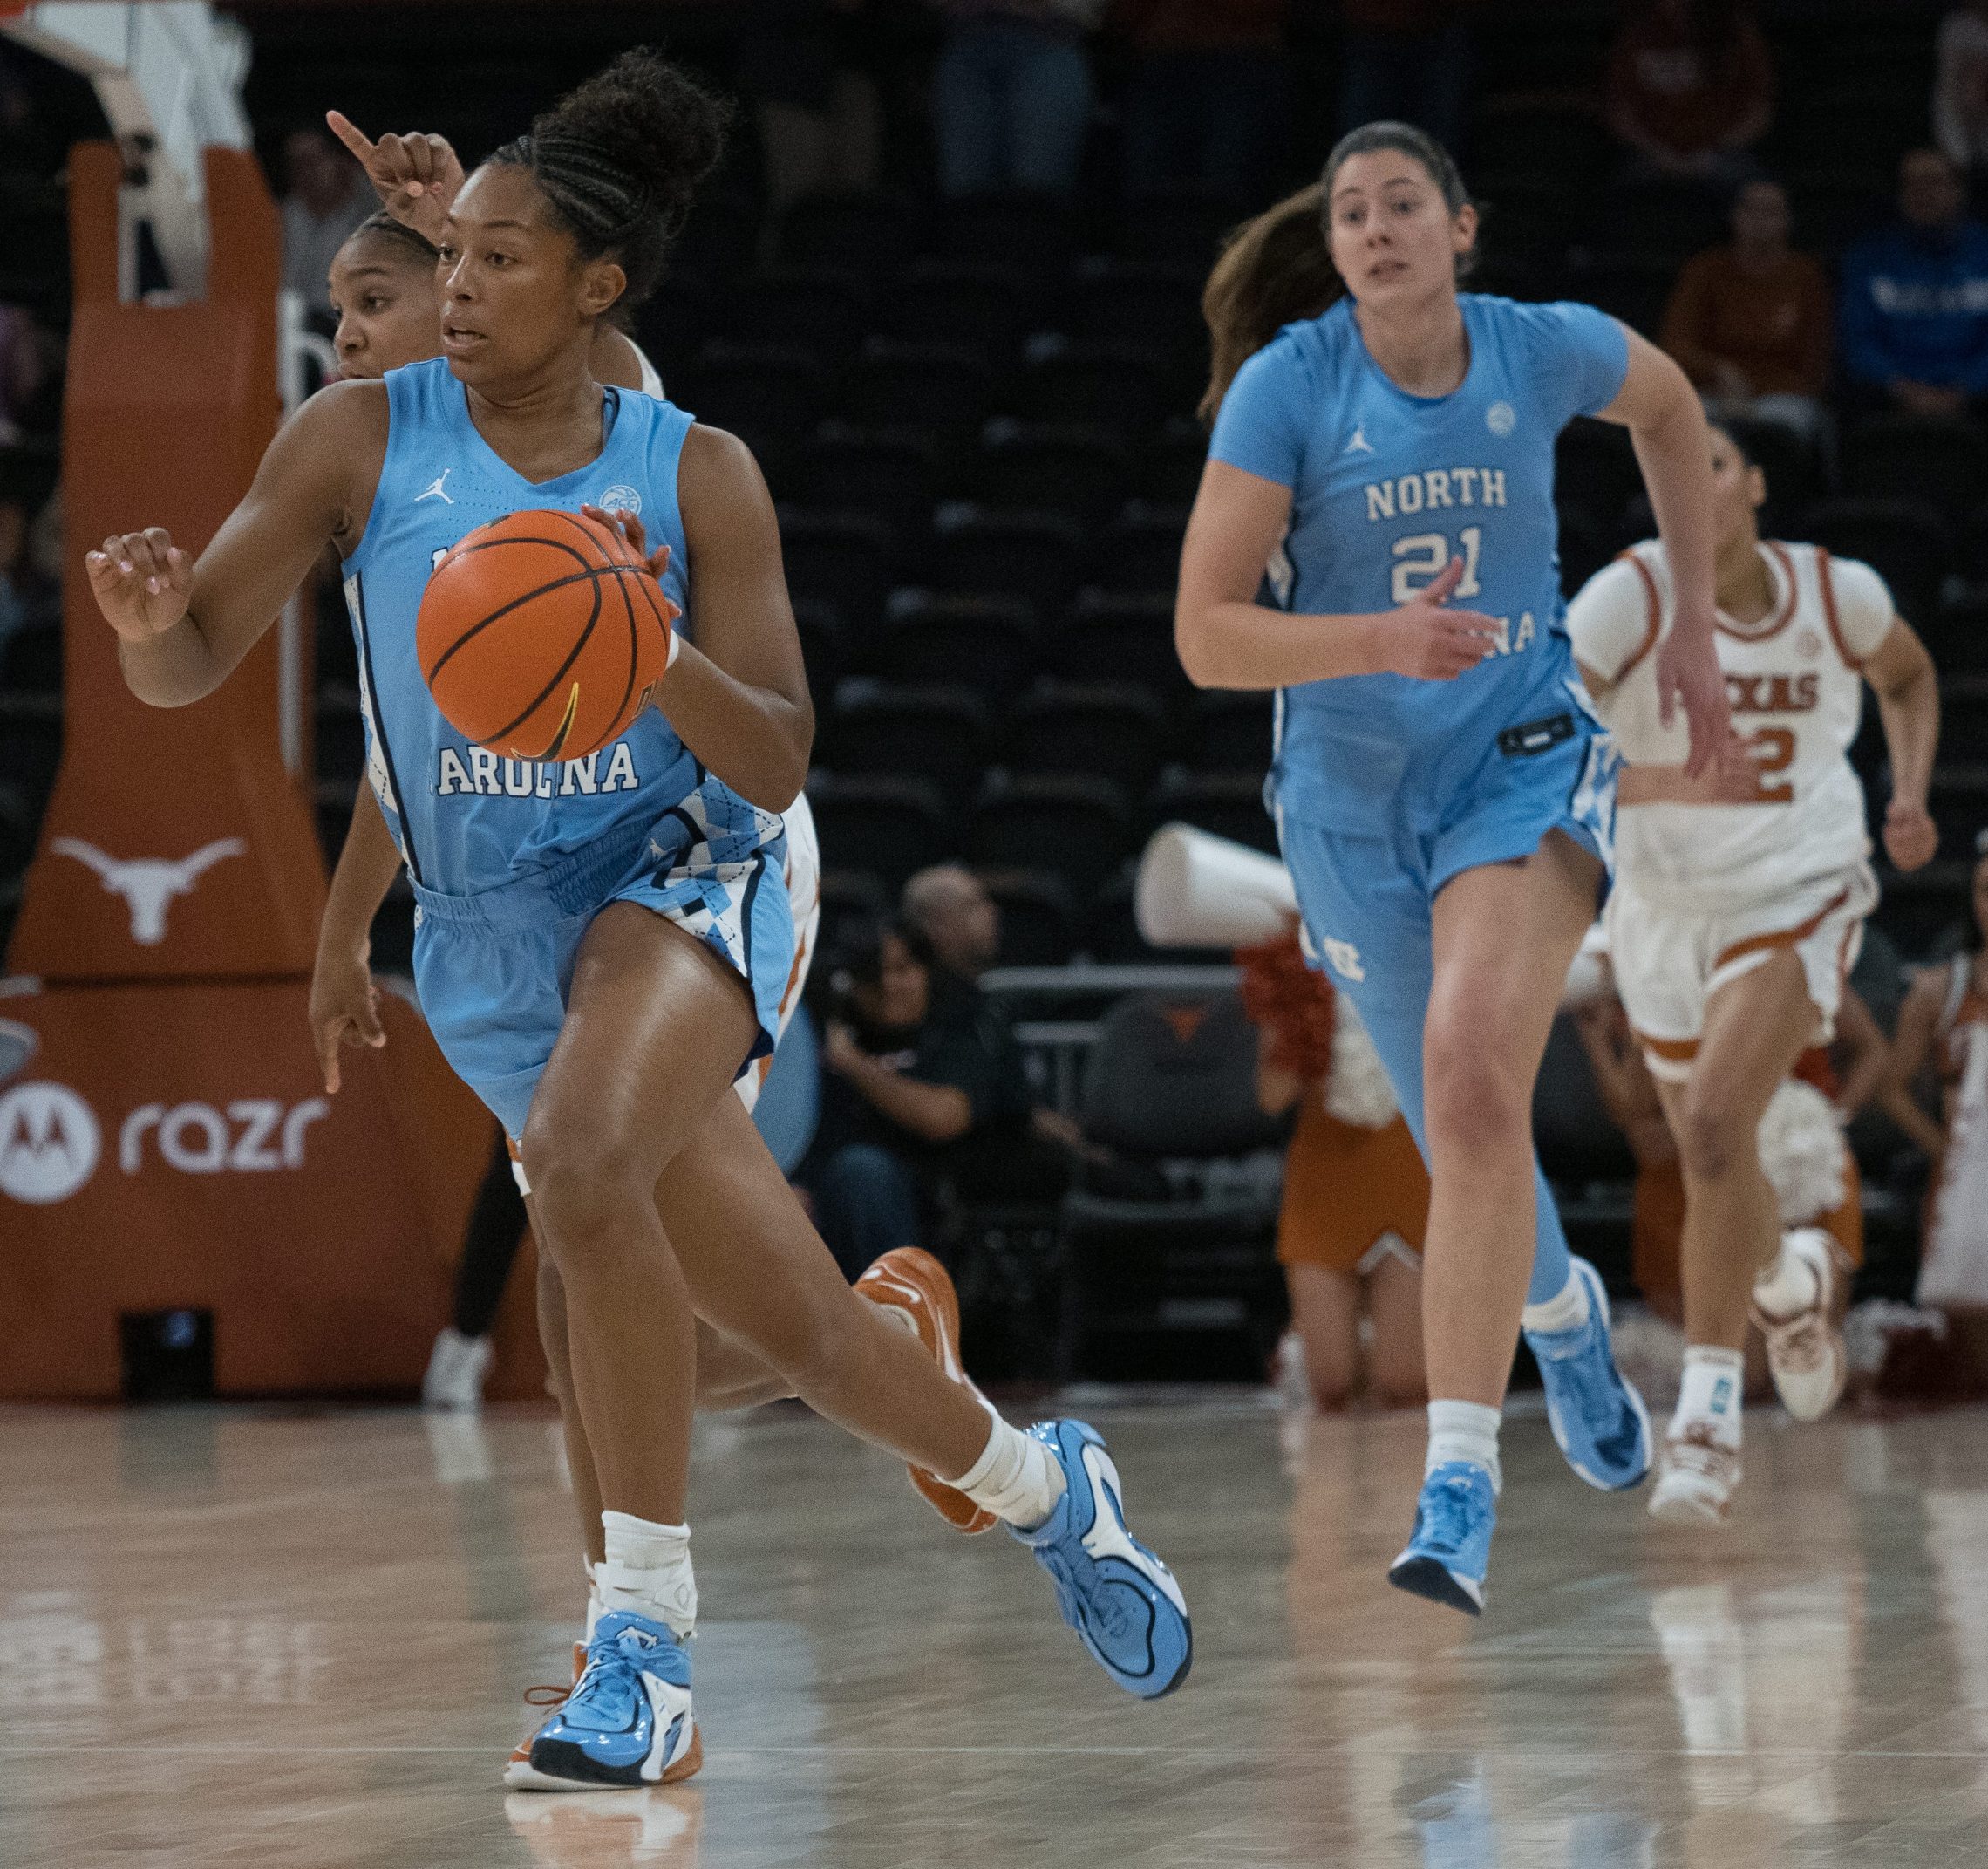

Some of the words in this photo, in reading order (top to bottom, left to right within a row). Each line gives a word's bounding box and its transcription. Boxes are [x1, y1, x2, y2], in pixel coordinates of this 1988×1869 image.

[1365, 467, 1508, 522] NORTH
[1391, 527, 1482, 604] 21
[1724, 671, 1820, 713] XAS
[119, 1098, 328, 1174] razr
